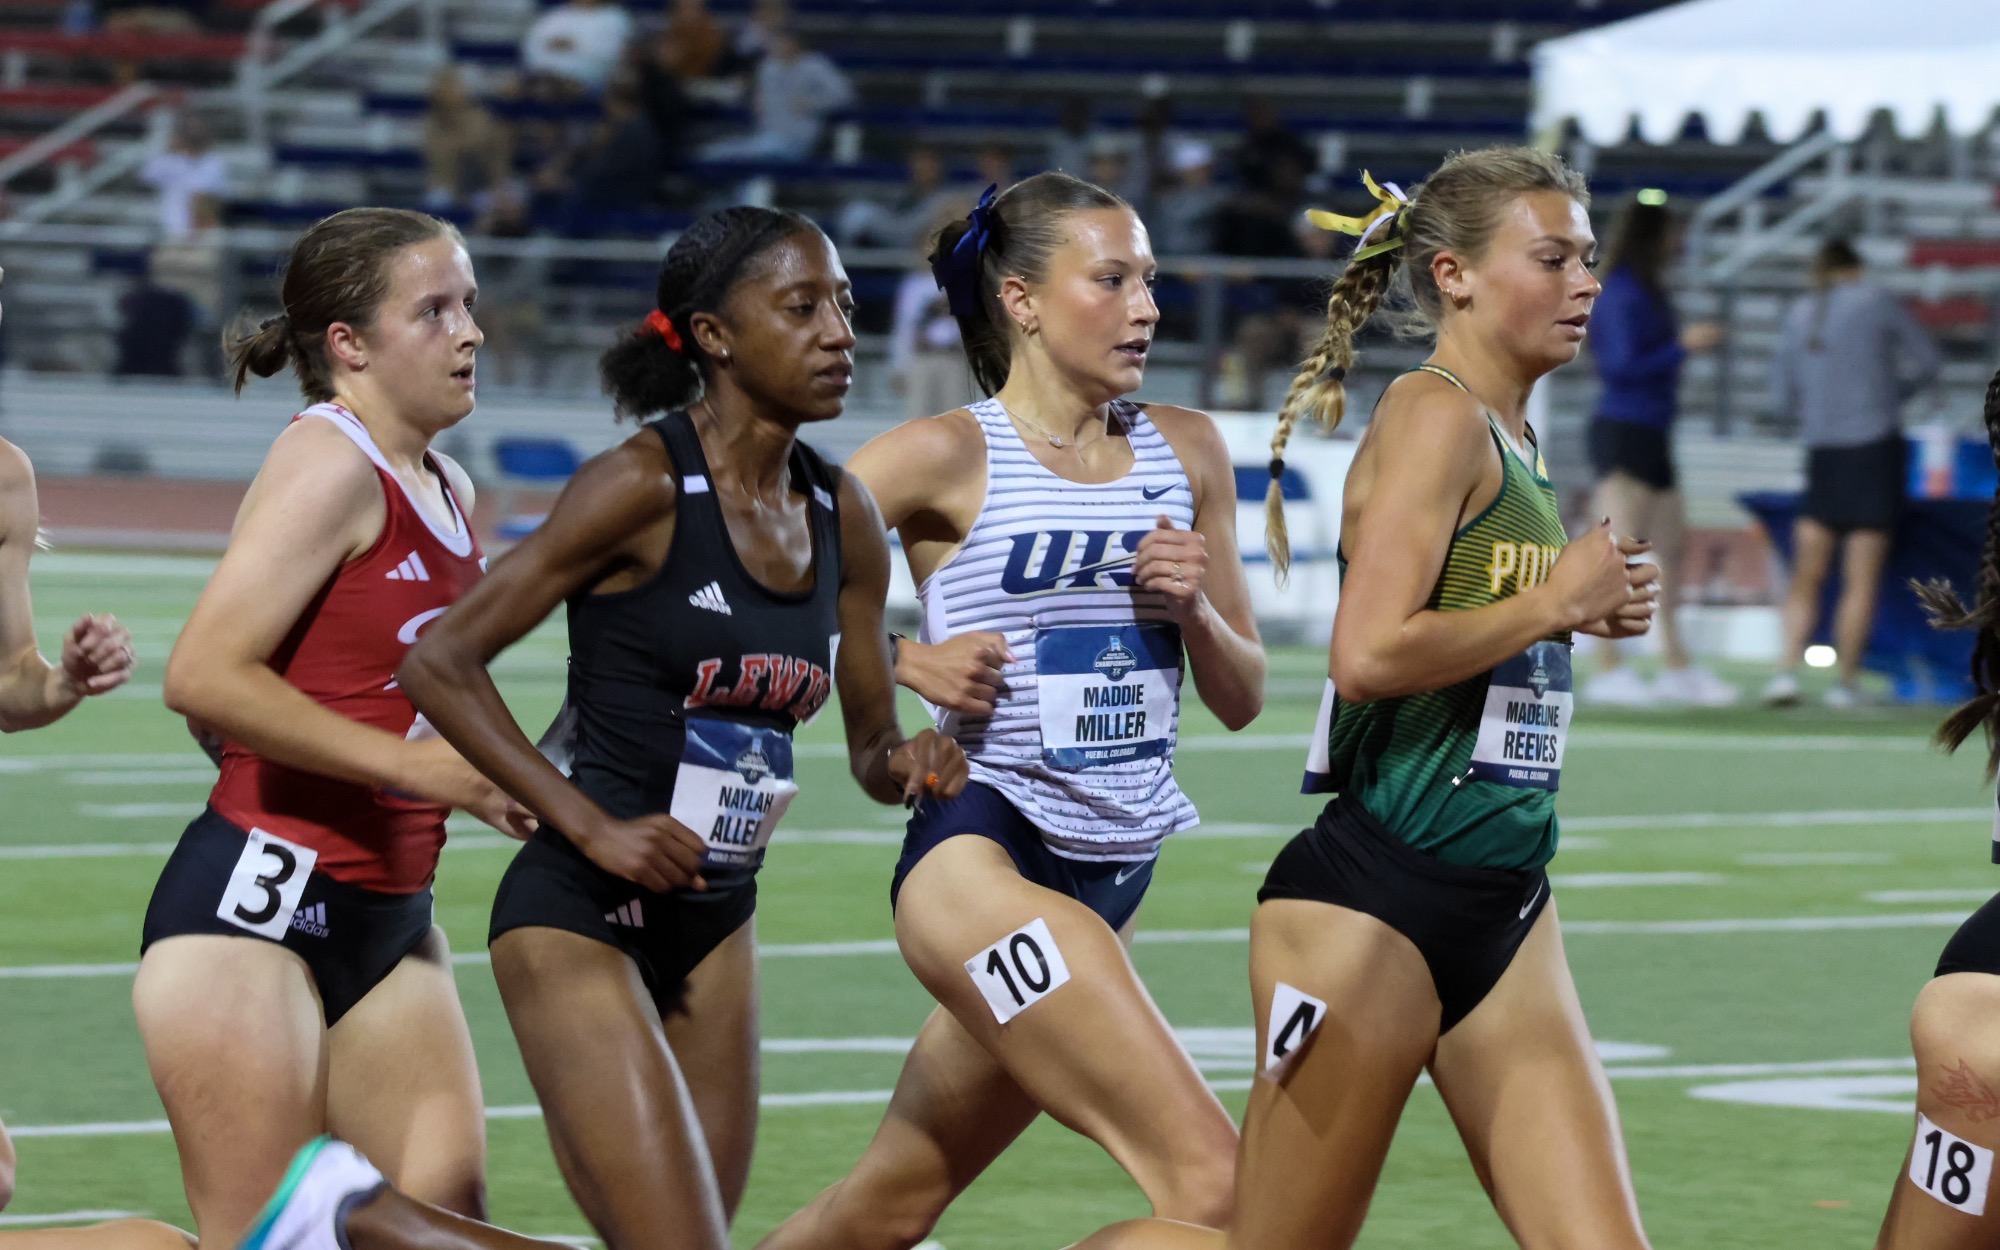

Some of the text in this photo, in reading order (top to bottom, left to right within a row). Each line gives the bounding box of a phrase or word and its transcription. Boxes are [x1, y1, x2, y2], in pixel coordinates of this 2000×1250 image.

[1083, 684, 1145, 708] MADDIE
[1075, 711, 1147, 743] MILLER
[1505, 701, 1560, 728] MADELINE
[1503, 730, 1558, 763] REEVES
[718, 786, 775, 814] NAYLAH
[233, 843, 297, 925] 3
[290, 916, 330, 938] didas
[986, 933, 1051, 1007] 10
[1925, 1129, 1975, 1205] 18
